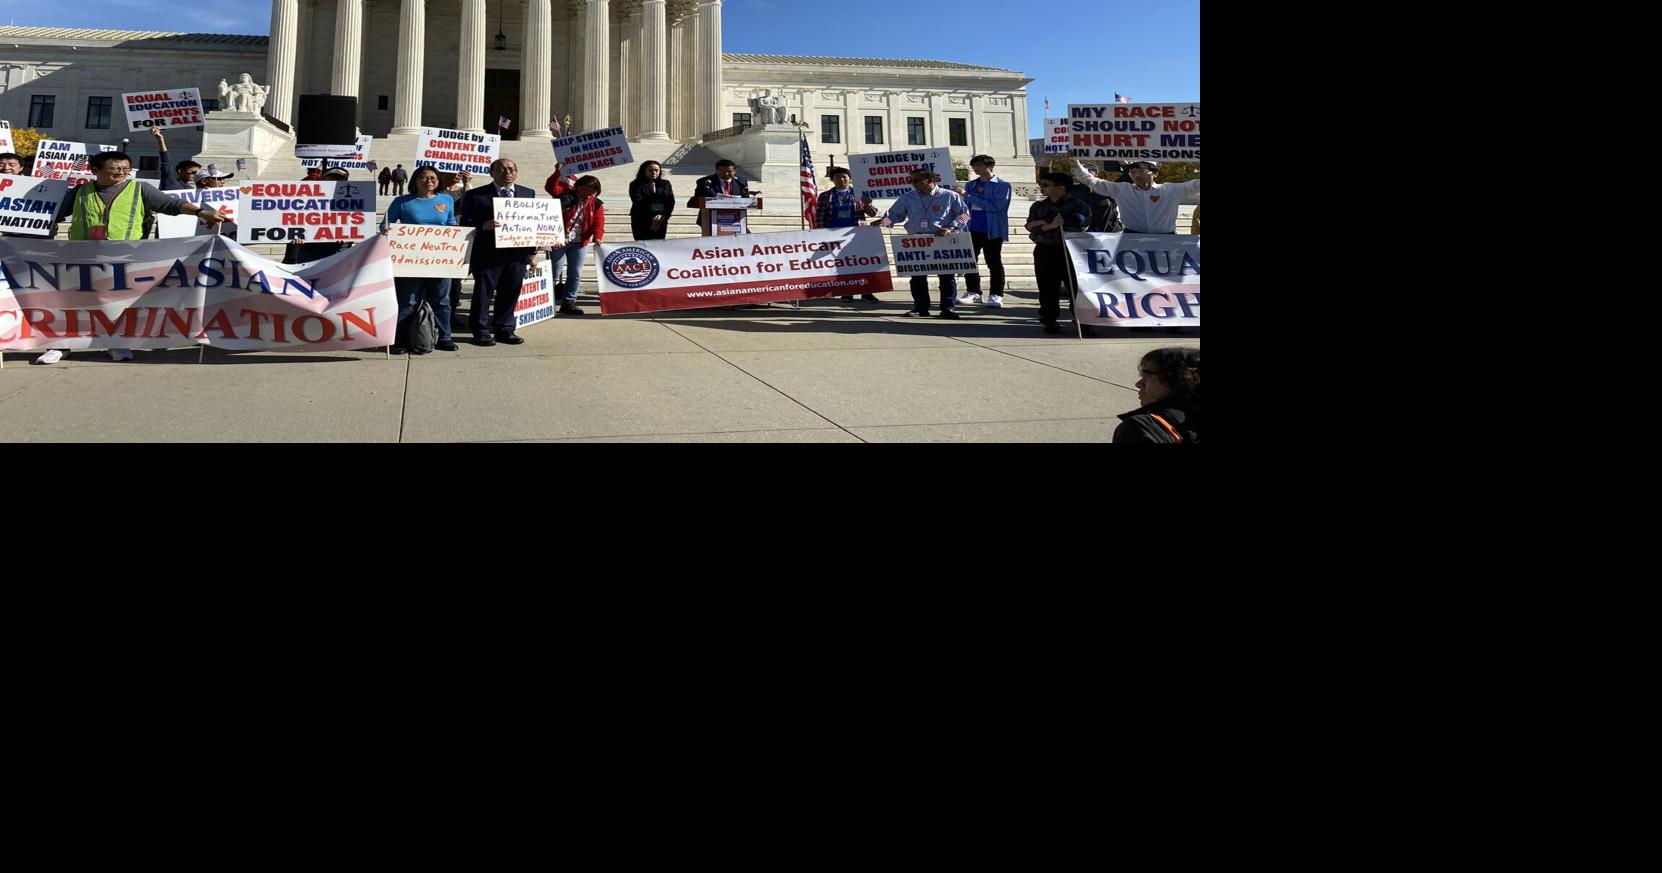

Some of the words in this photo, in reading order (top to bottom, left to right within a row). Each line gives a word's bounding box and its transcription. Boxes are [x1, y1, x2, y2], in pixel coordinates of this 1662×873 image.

[126, 92, 172, 104] EQUAL
[128, 99, 198, 112] EDUCATION
[1071, 107, 1106, 118] MY
[1113, 106, 1175, 118] RACE
[148, 107, 200, 119] RIGHTS
[132, 118, 167, 129] FOR
[170, 115, 202, 126] ALL
[1071, 120, 1156, 132] SHOULD
[437, 129, 470, 141] JUDGE
[472, 133, 485, 143] by
[552, 137, 574, 149] HELP
[575, 127, 623, 143] STUDENTS
[1072, 133, 1151, 147] HURT
[1160, 134, 1200, 147] ME
[41, 141, 47, 150] I
[49, 142, 72, 152] AM
[429, 139, 476, 152] CONTENT
[477, 144, 491, 154] OF
[571, 145, 581, 154] IN
[582, 139, 612, 152] NEEDS
[1071, 148, 1090, 158] IN
[1094, 148, 1200, 159] ADMISSIONS
[38, 151, 68, 161] ASIAN
[424, 149, 492, 164] CHARACTERS
[564, 146, 624, 165] REGARDLESS
[874, 153, 909, 164] JUDGE
[911, 152, 925, 162] by
[301, 159, 320, 168] NOT
[341, 160, 367, 169] COLOR
[438, 161, 463, 172] SKIN
[465, 164, 491, 175] COLO
[577, 162, 590, 172] OF
[591, 157, 616, 170] RACE
[868, 163, 920, 176] CONTENT
[251, 183, 326, 197] EQUAL
[0, 197, 57, 215] ASIAN
[250, 198, 365, 211] EDUCATION
[504, 199, 549, 211] ABOLISH
[282, 211, 366, 226] RIGHTS
[251, 227, 306, 241] FOR
[314, 227, 365, 240] ALL
[397, 226, 462, 239] SUPPORT
[536, 223, 556, 233] NOW
[389, 239, 417, 251] Race
[902, 237, 934, 248] STOP
[692, 245, 745, 261] Asian
[751, 239, 842, 257] American
[897, 250, 931, 262] ANTI-
[934, 248, 972, 260] ASIAN
[616, 262, 648, 272] AACE
[667, 262, 750, 280] Coalition
[756, 260, 784, 275] for
[790, 253, 881, 271] Education
[896, 261, 977, 274] DISCRIMINATION
[1086, 249, 1200, 281] EQUA
[541, 278, 547, 290] OF
[1093, 291, 1200, 319] RIGH
[519, 310, 535, 326] SKIN
[536, 305, 554, 321] COLOR
[0, 306, 377, 344] CRIMINATION
